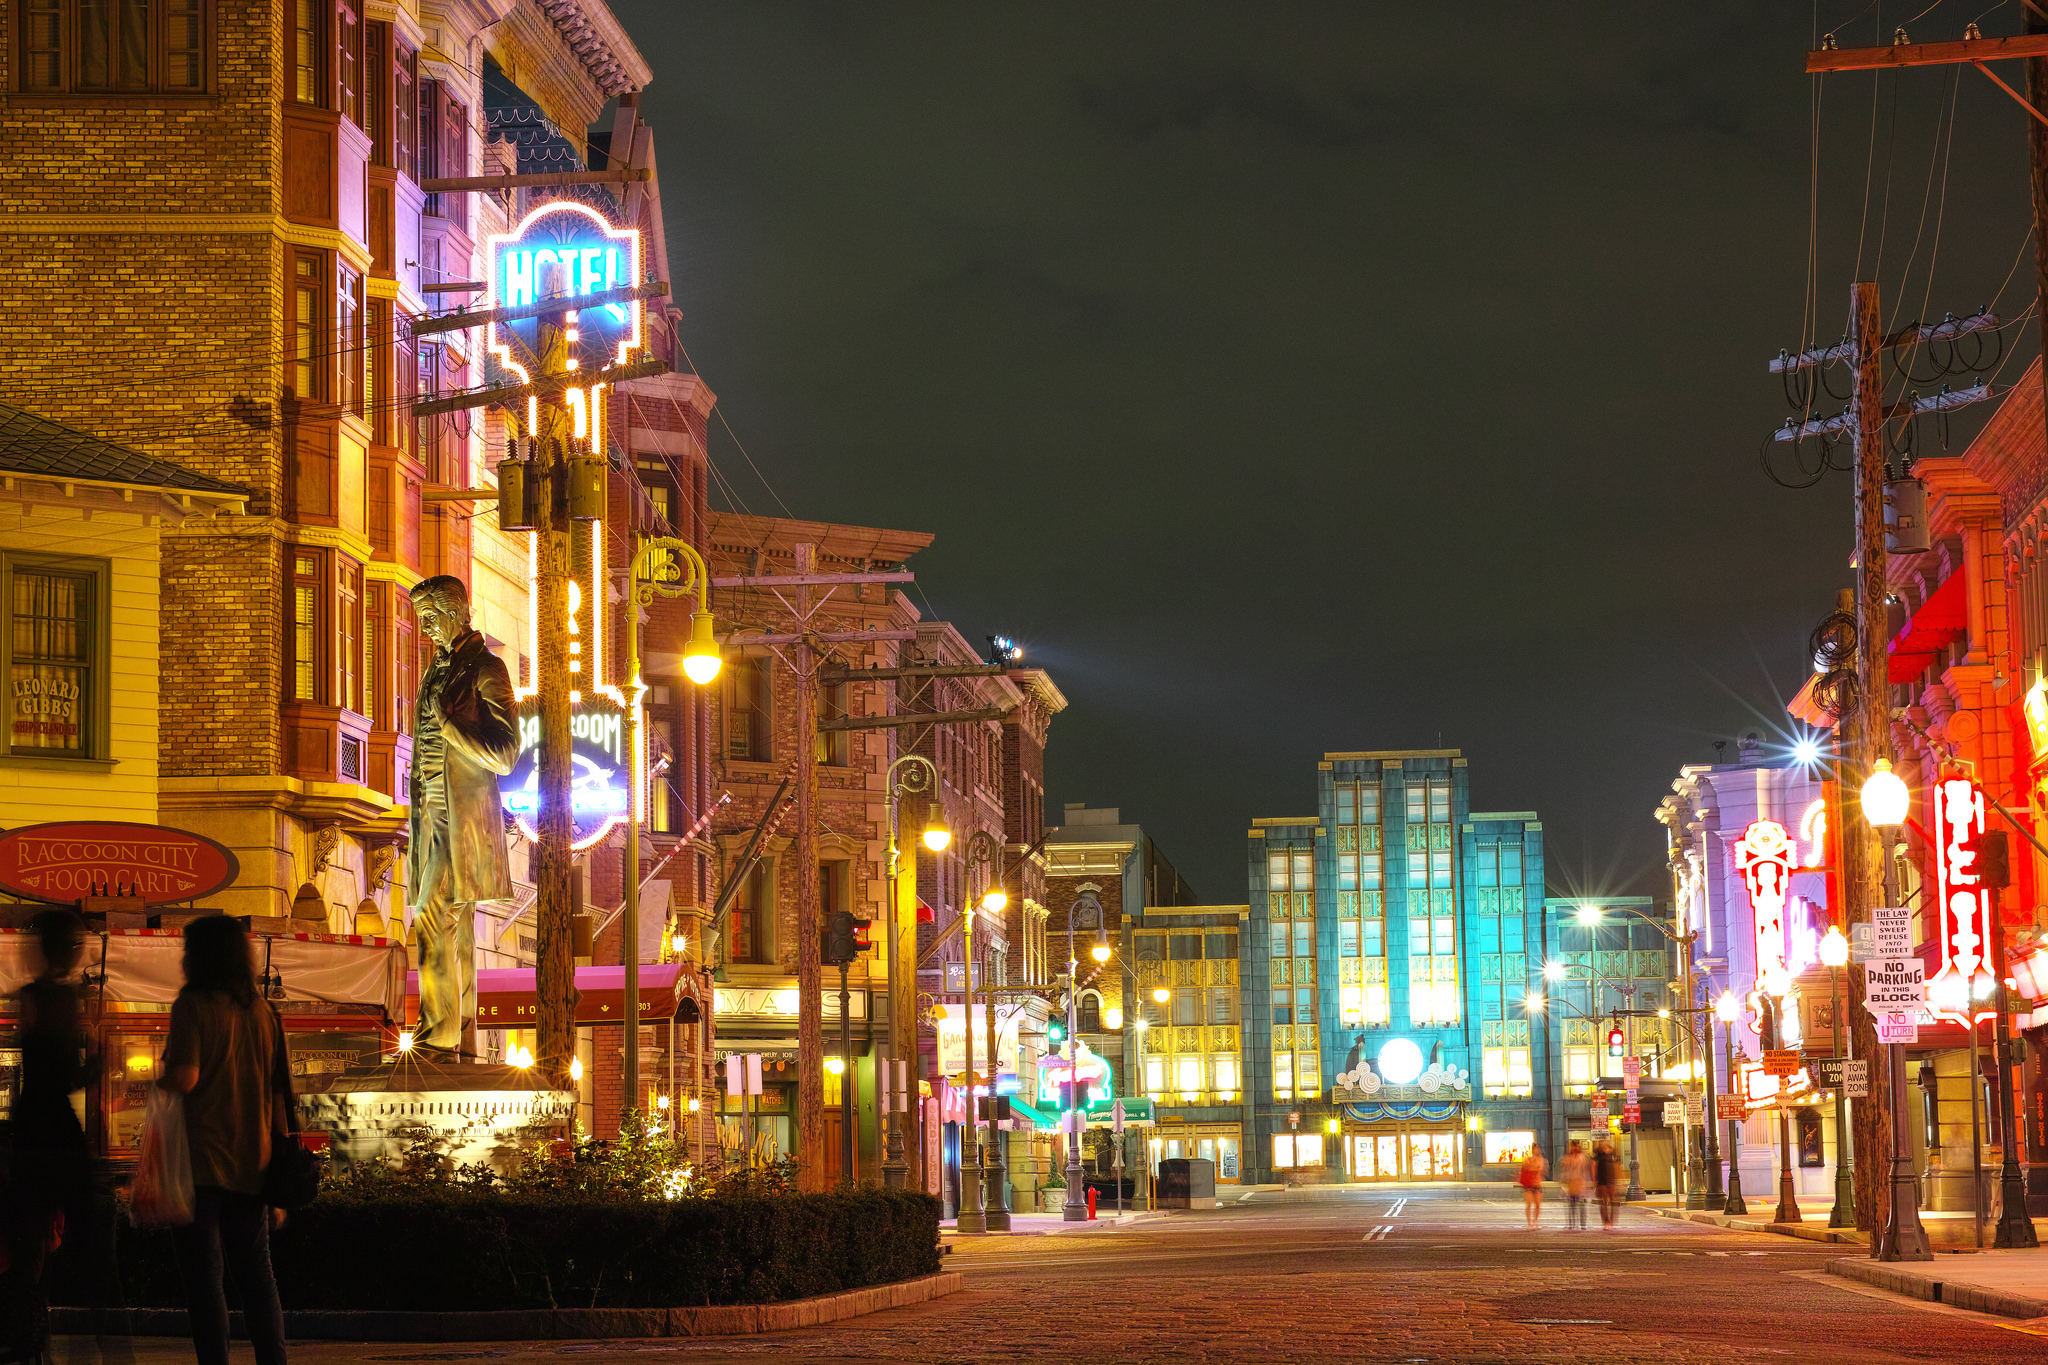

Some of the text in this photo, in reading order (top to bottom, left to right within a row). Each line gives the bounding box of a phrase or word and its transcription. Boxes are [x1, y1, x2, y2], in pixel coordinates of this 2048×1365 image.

[13, 678, 80, 701] LEONARD
[21, 697, 71, 718] GIBBS
[17, 841, 198, 870] RACCOON CITY
[45, 868, 174, 893] FOOD CART
[1884, 962, 1904, 973] NO
[1868, 968, 1922, 985] PARKING
[1871, 993, 1921, 1002] BLOCK
[1888, 1014, 1906, 1025] NO
[1881, 1025, 1914, 1038] U TURN
[291, 1052, 359, 1062] RACCOON CITY
[1847, 1063, 1866, 1072] TOW
[929, 1106, 938, 1189] SANDWICHES
